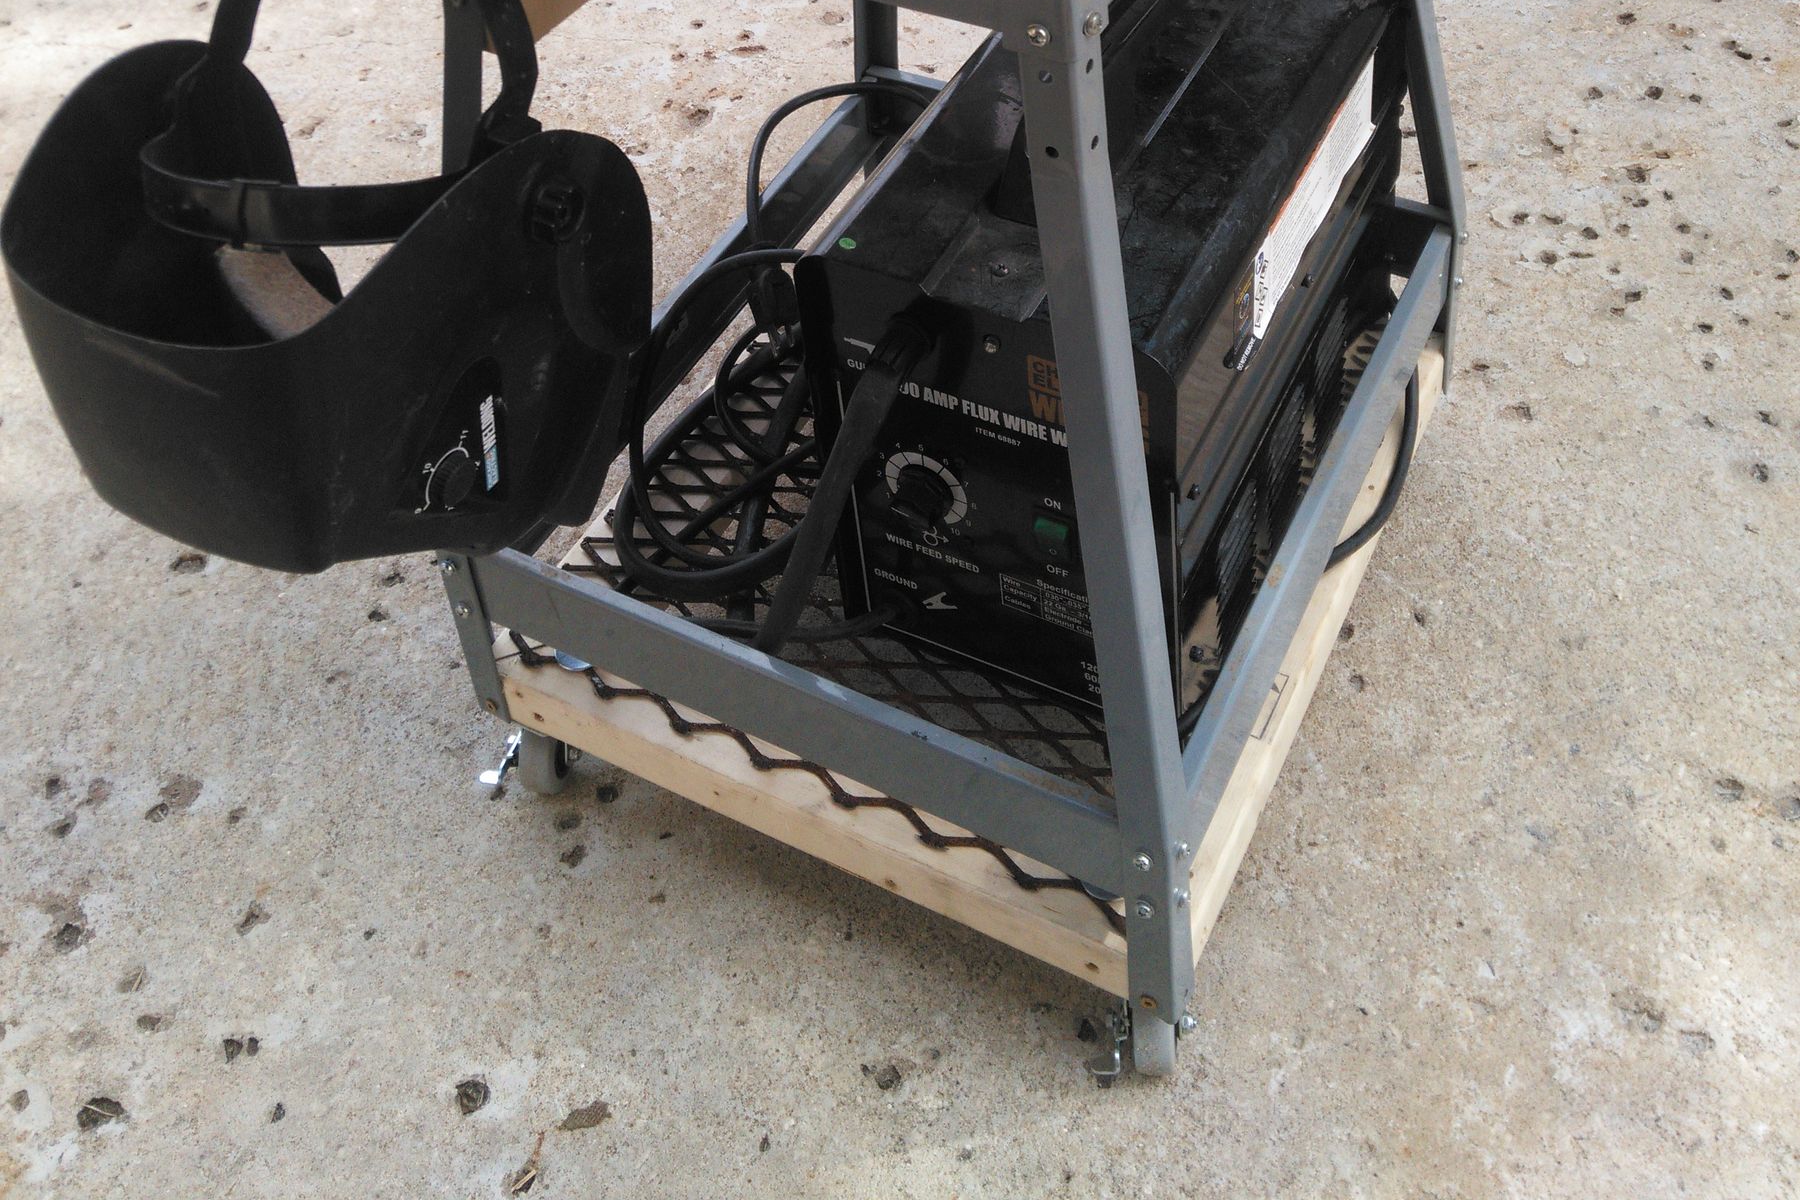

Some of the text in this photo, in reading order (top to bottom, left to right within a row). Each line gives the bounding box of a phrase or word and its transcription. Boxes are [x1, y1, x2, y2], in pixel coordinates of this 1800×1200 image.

[923, 386, 960, 410] AMP
[962, 398, 1001, 426] FLUX
[1002, 412, 1048, 441] WIRE
[975, 427, 996, 439] ITEM
[1044, 497, 1062, 511] ON
[951, 527, 960, 536] 10
[886, 532, 980, 574] WIRE FEED SPEED
[1046, 563, 1070, 578] OFF
[874, 568, 919, 590] GROUND
